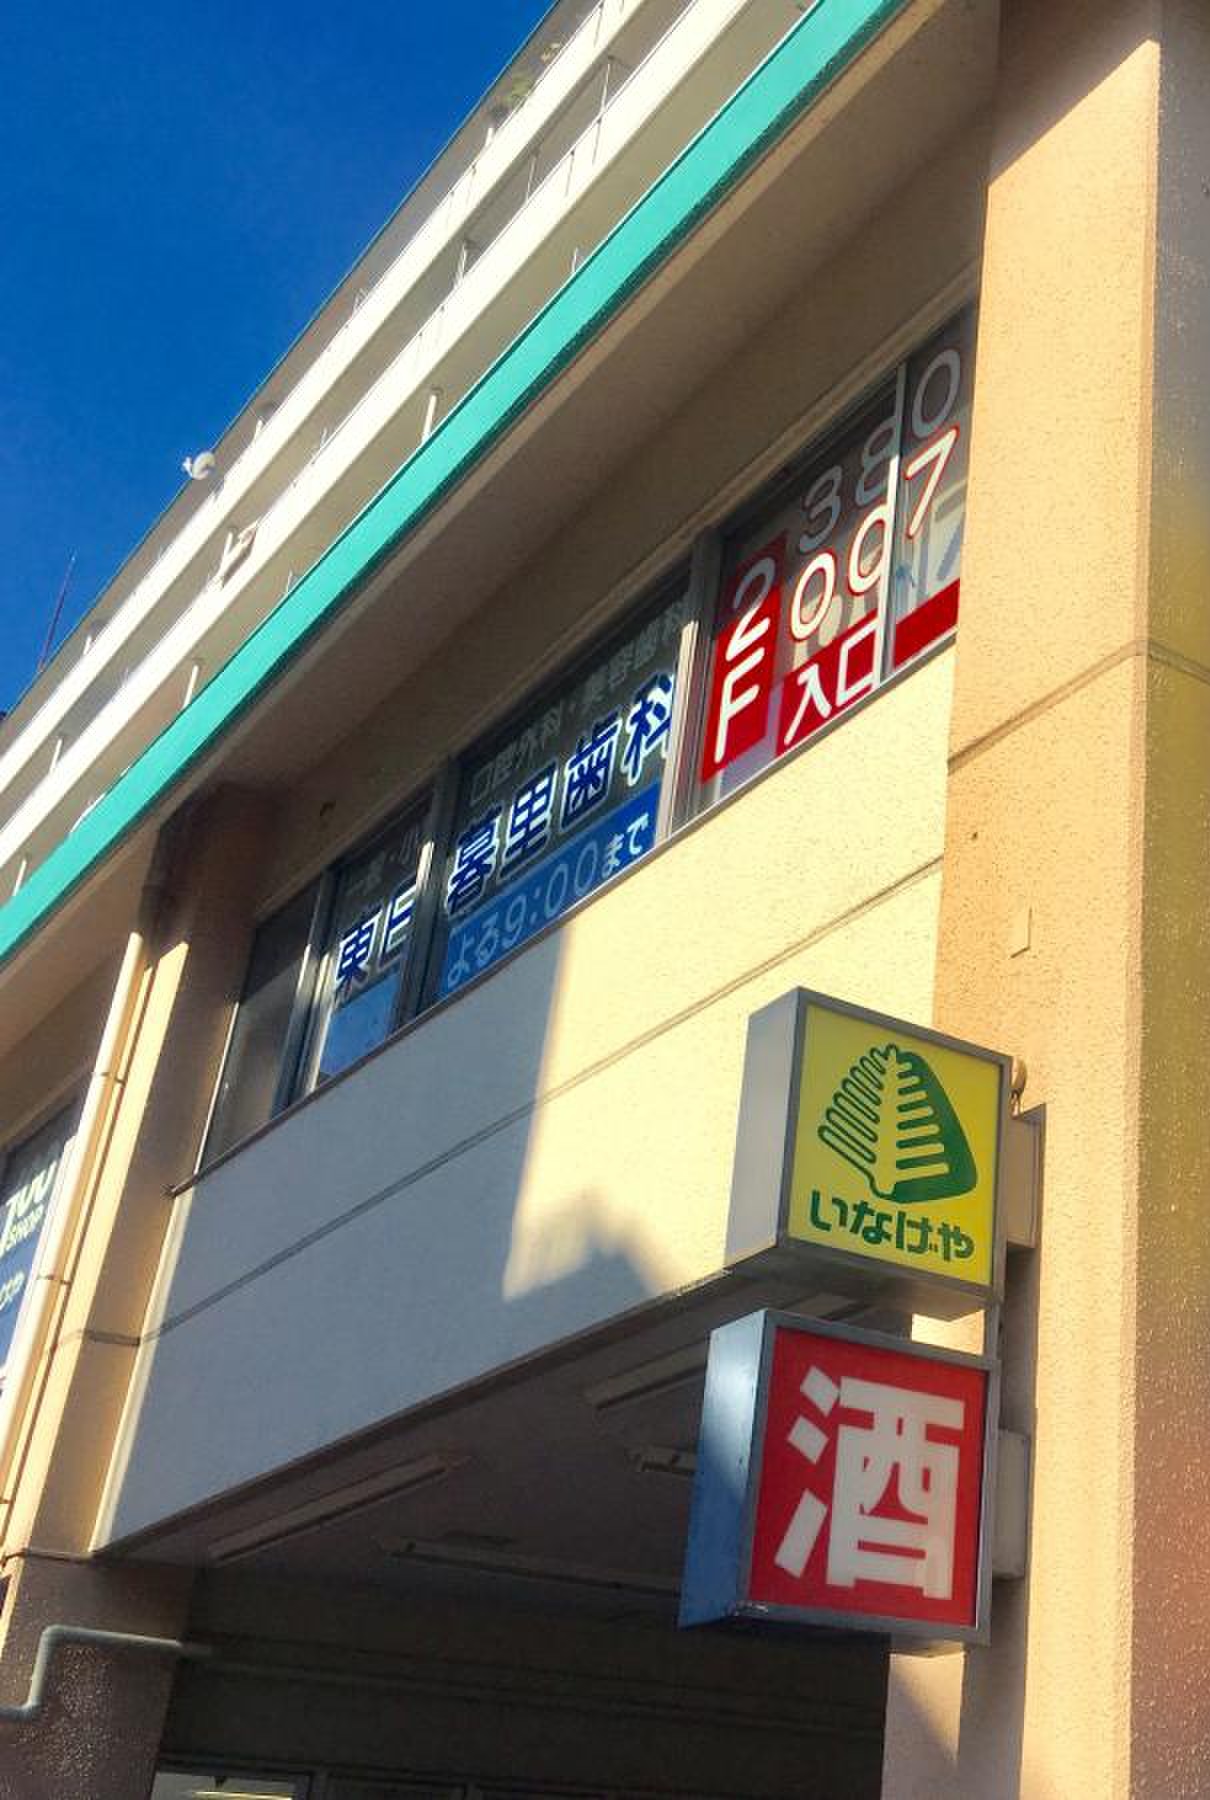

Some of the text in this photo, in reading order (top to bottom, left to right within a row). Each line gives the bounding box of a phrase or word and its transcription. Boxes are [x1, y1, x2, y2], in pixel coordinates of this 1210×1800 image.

[712, 556, 777, 766] 2F
[784, 620, 882, 748] 入口
[810, 1189, 974, 1262] いなげや
[774, 1366, 964, 1600] 酒
